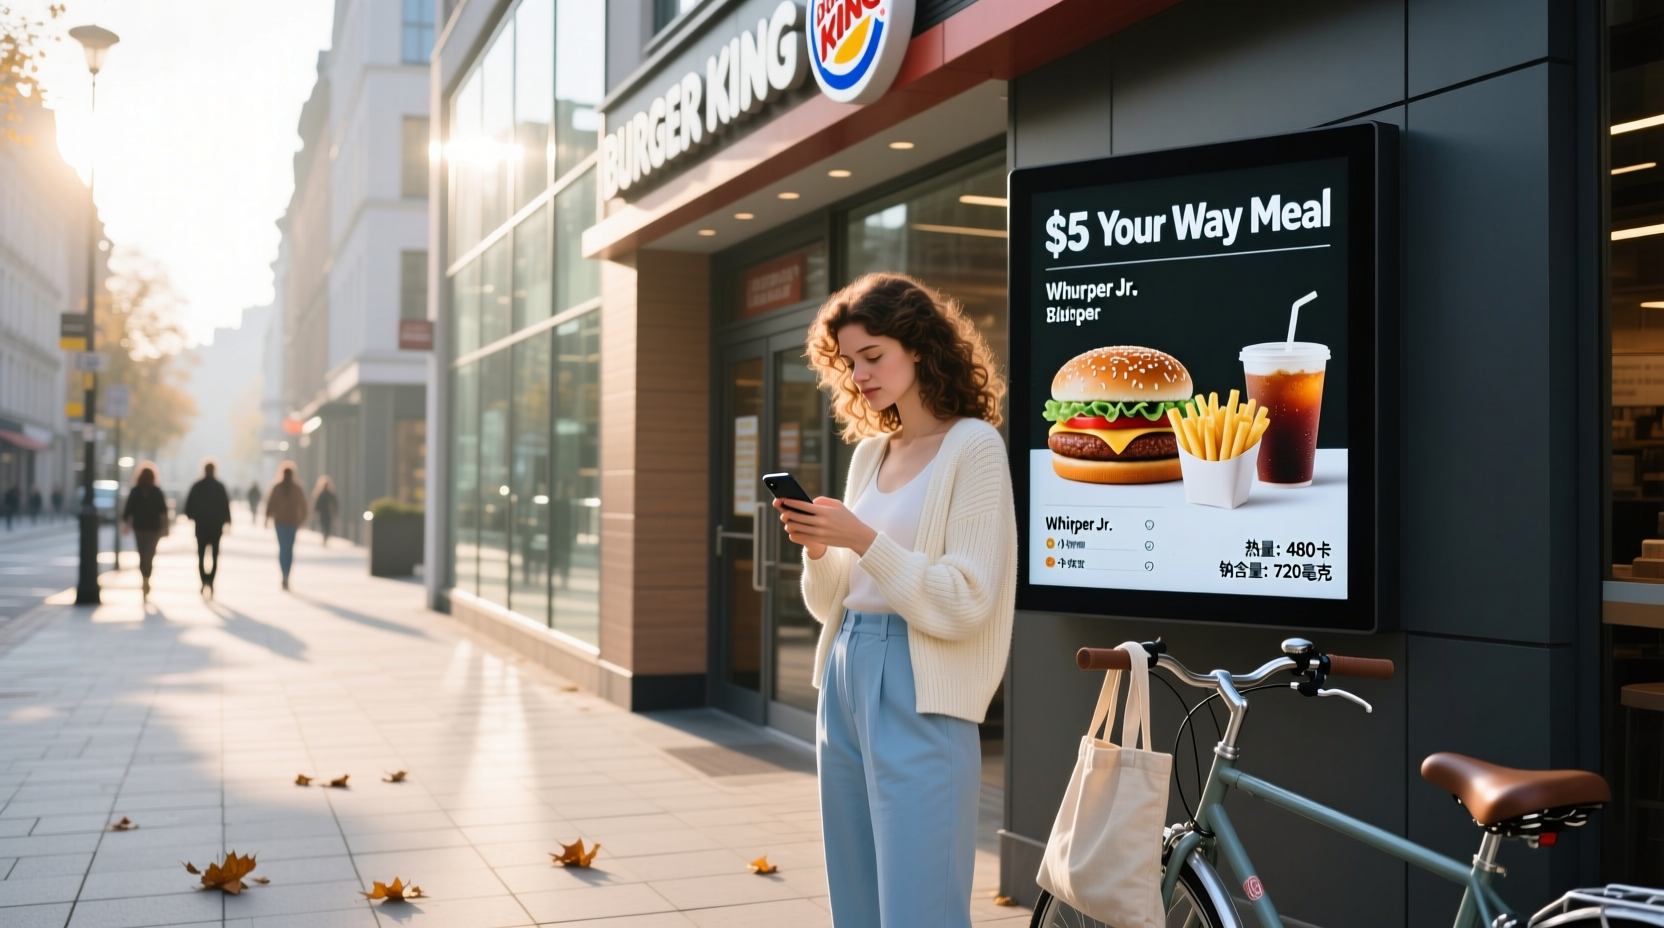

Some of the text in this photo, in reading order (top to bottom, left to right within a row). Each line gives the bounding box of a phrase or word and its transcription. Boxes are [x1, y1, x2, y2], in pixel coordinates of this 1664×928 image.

[821, 0, 881, 63] KIN
[603, 1, 797, 201] BURGER KING
[1045, 187, 1331, 259] $5 Your Way Meal
[1115, 277, 1138, 297] Jr.
[1096, 518, 1113, 531] Jr.
